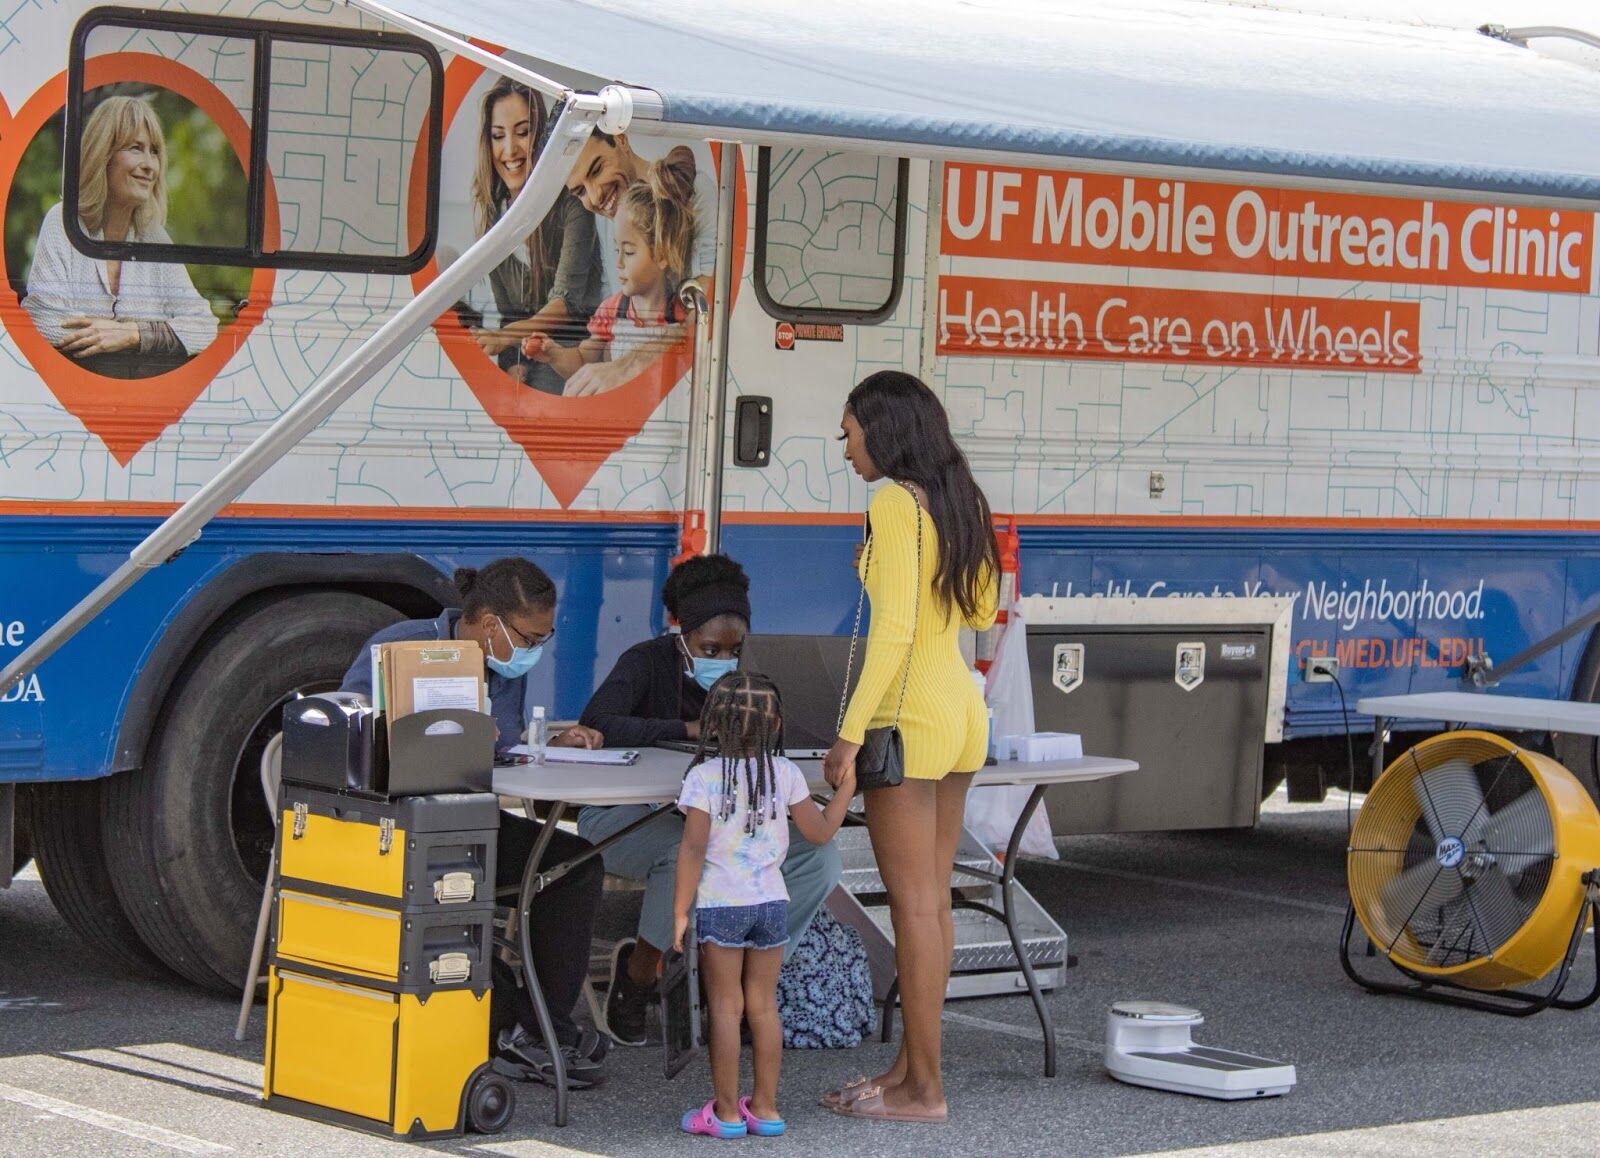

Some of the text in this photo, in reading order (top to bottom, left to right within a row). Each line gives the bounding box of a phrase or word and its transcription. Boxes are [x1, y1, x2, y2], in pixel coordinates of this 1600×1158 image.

[946, 168, 1583, 279] UF Mobile Outreach Clinic
[778, 332, 793, 340] STOP
[939, 288, 1414, 365] Health Care on Wheels
[1302, 578, 1485, 631] Neighborhood.
